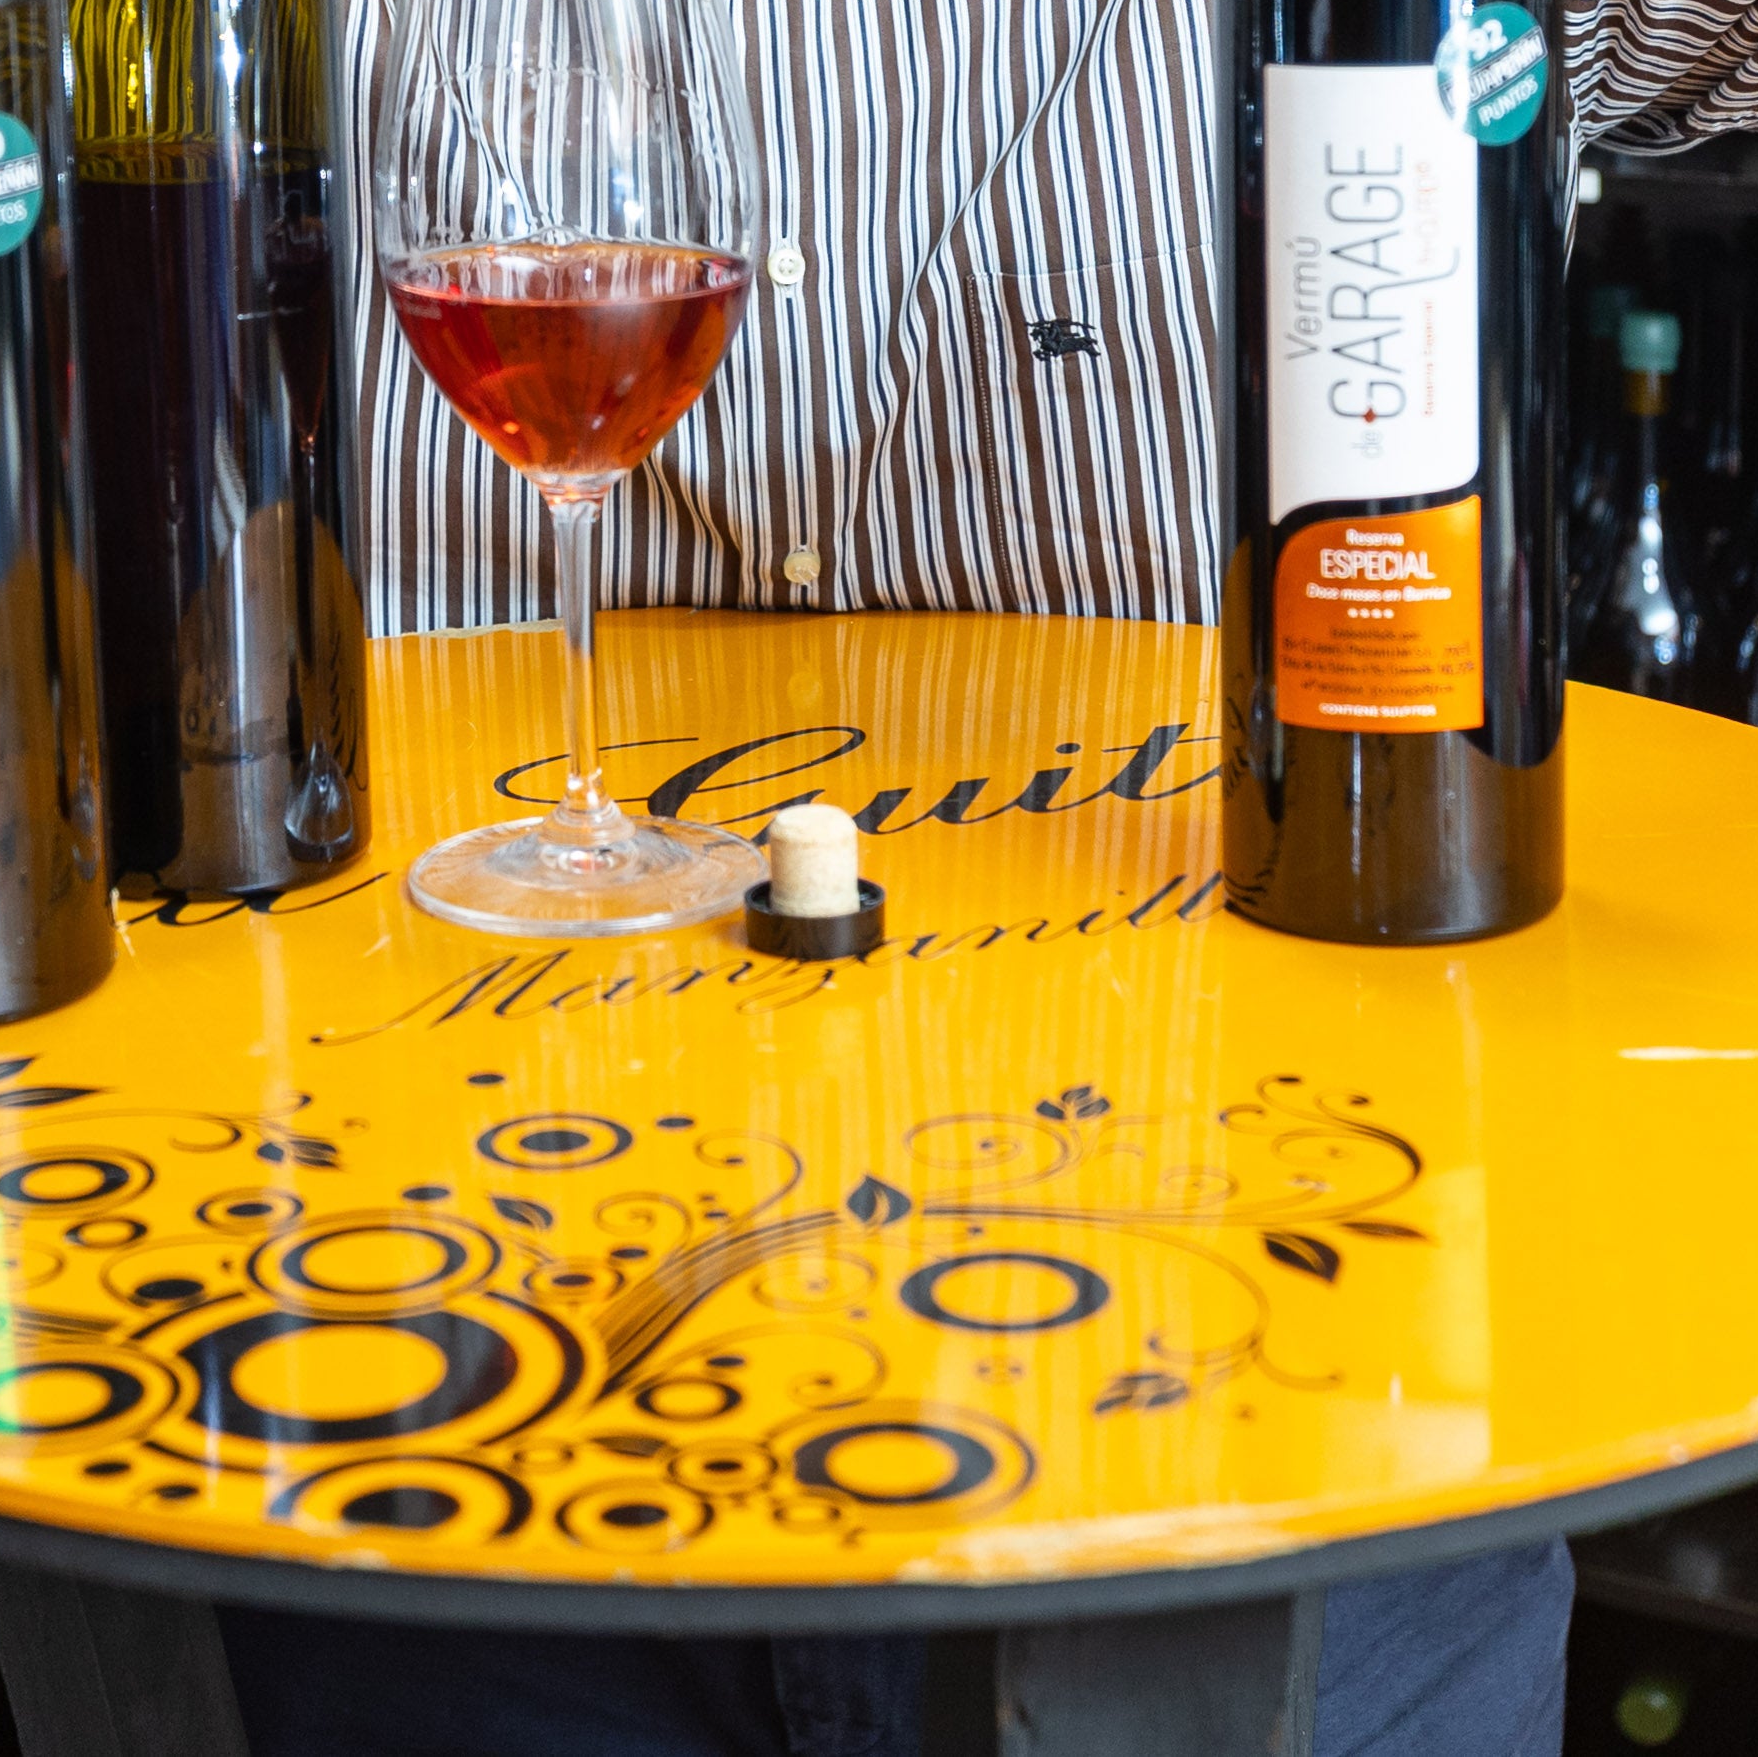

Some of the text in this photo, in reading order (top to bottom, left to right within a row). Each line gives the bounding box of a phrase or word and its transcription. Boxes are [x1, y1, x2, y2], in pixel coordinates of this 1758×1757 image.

[1477, 73, 1539, 126] PUNTOS
[1285, 235, 1322, 362] Vermú
[1324, 143, 1460, 420] GARAGE
[1351, 428, 1385, 460] de
[1319, 548, 1438, 581] ESPECIAL
[1346, 528, 1405, 546] Reserva
[493, 723, 1222, 846] Guit
[309, 868, 1224, 1045] Manzanill
